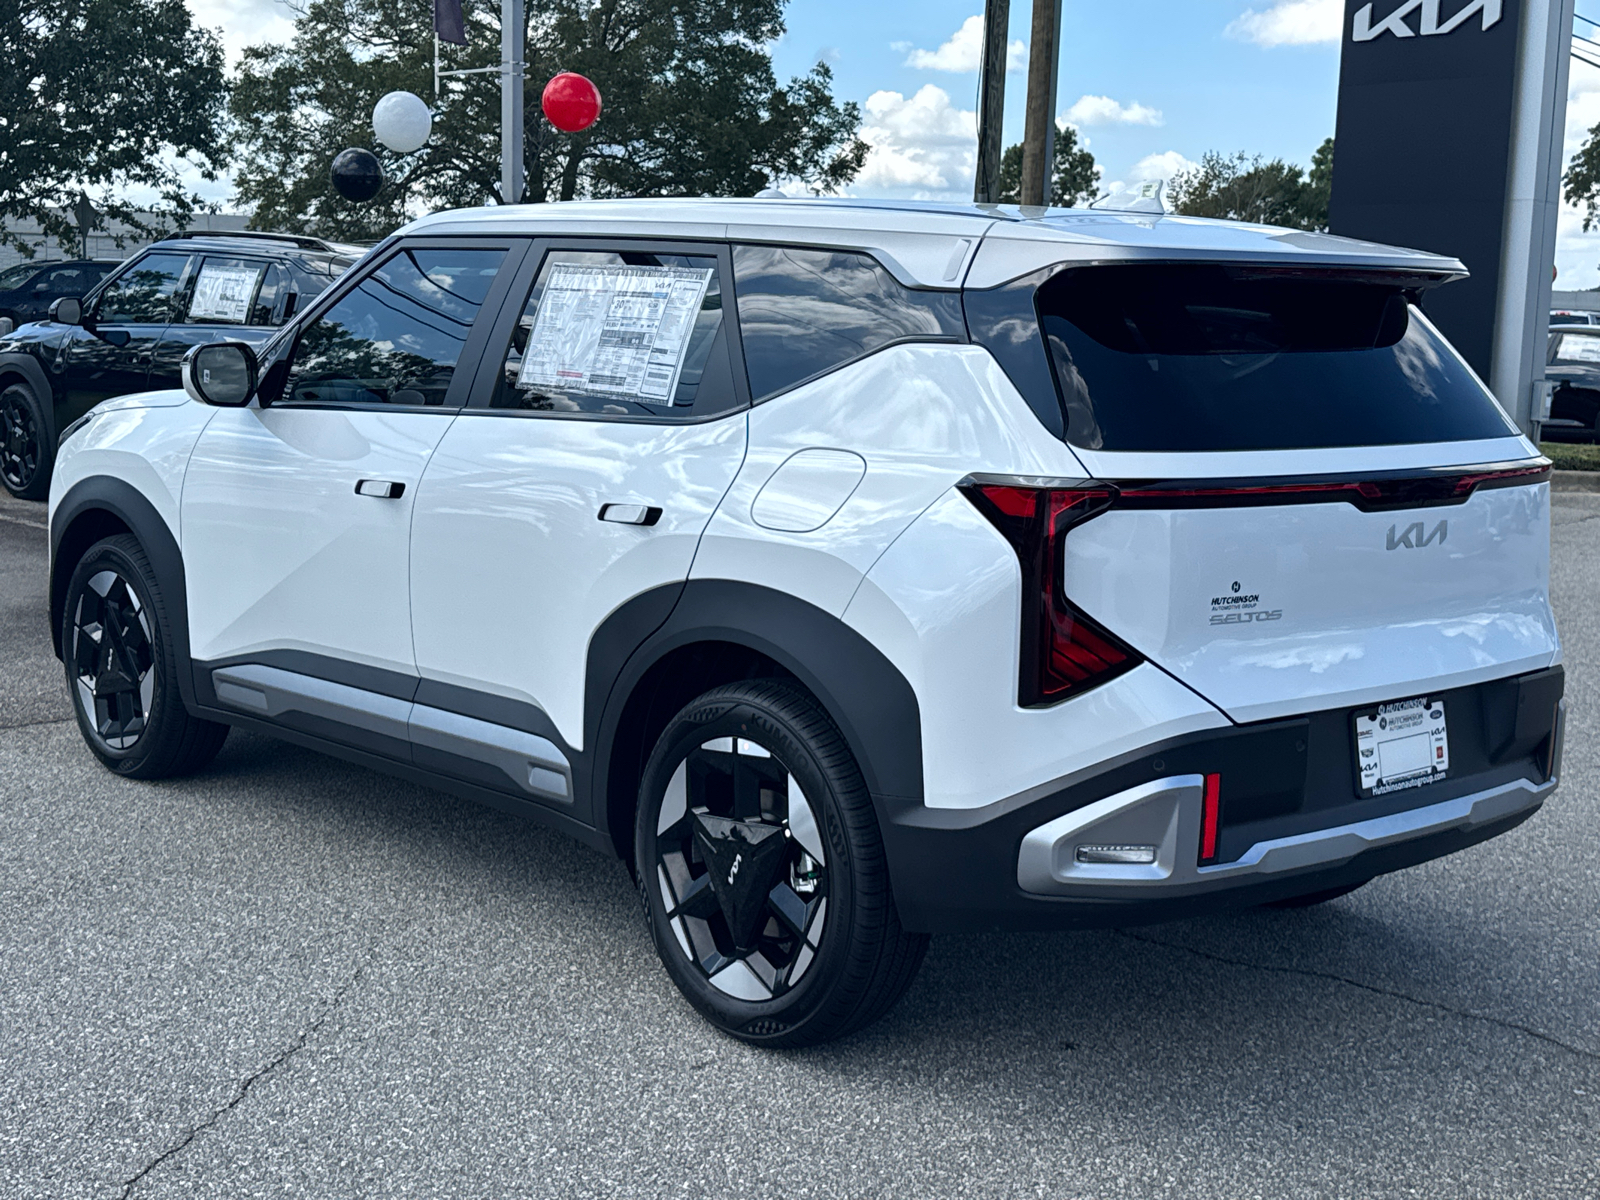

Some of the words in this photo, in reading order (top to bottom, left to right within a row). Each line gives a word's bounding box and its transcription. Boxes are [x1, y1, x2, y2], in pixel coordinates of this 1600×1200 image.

[1352, 0, 1503, 42] KIA
[1386, 520, 1448, 551] KIA
[1211, 594, 1260, 606] HUTCHINSON
[1209, 609, 1283, 625] SELTOS
[1386, 697, 1428, 714] HUTCHINSON
[1388, 712, 1424, 726] HUTCHINSON
[751, 713, 811, 771] KUMHO
